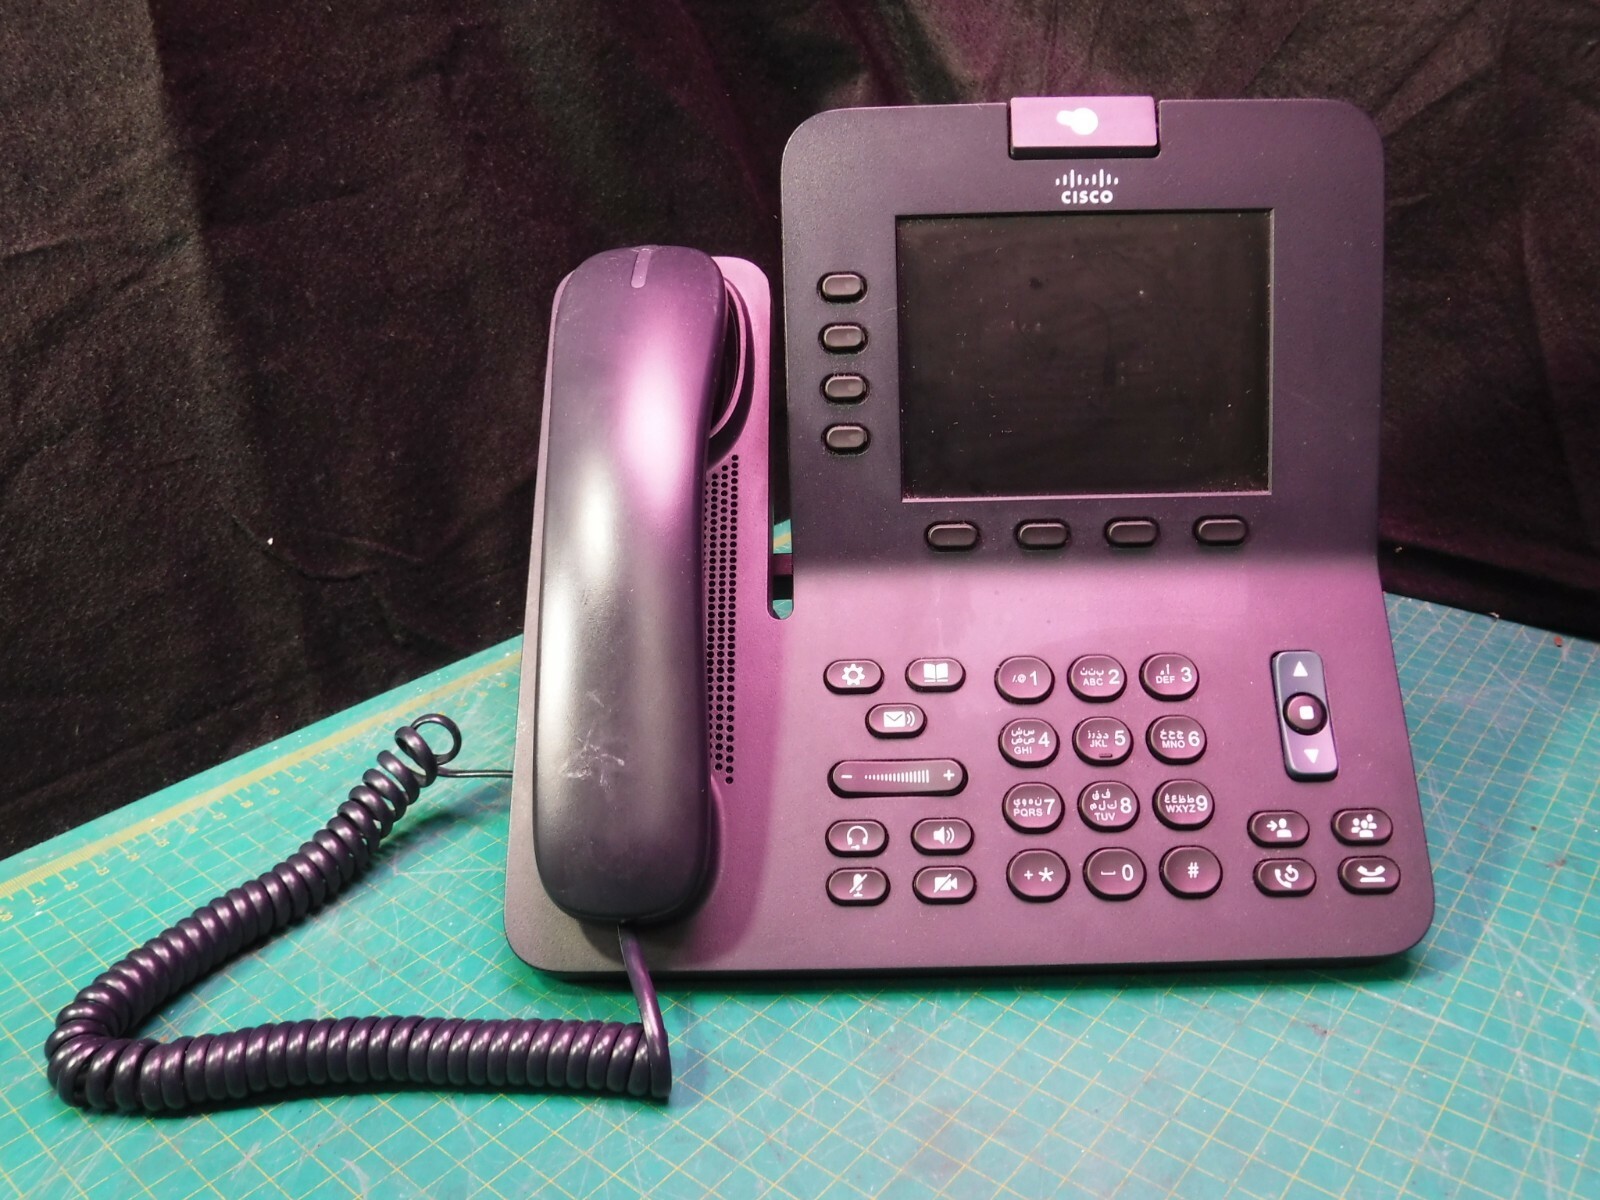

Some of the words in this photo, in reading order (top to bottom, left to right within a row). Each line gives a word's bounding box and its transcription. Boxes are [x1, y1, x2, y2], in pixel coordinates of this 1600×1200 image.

[1061, 190, 1113, 204] CISCO
[1029, 670, 1037, 686] 1
[1083, 677, 1103, 686] ABC
[1108, 669, 1120, 684] 2
[1155, 675, 1175, 684] DEF
[1181, 666, 1192, 682] 3
[1038, 731, 1050, 747] 4
[1089, 739, 1108, 747] JKL
[1114, 730, 1126, 746] 5
[1162, 740, 1185, 748] MNO
[1188, 731, 1200, 747] 6
[1014, 746, 1032, 754] GHI
[1044, 799, 1055, 815] 7
[1120, 797, 1132, 813] 8
[1165, 804, 1196, 813] WXYZ
[1195, 795, 1208, 811] 9
[1013, 808, 1043, 817] PQRS
[1094, 812, 1115, 821] TUV
[1121, 864, 1134, 881] 0
[1187, 862, 1200, 879] #
